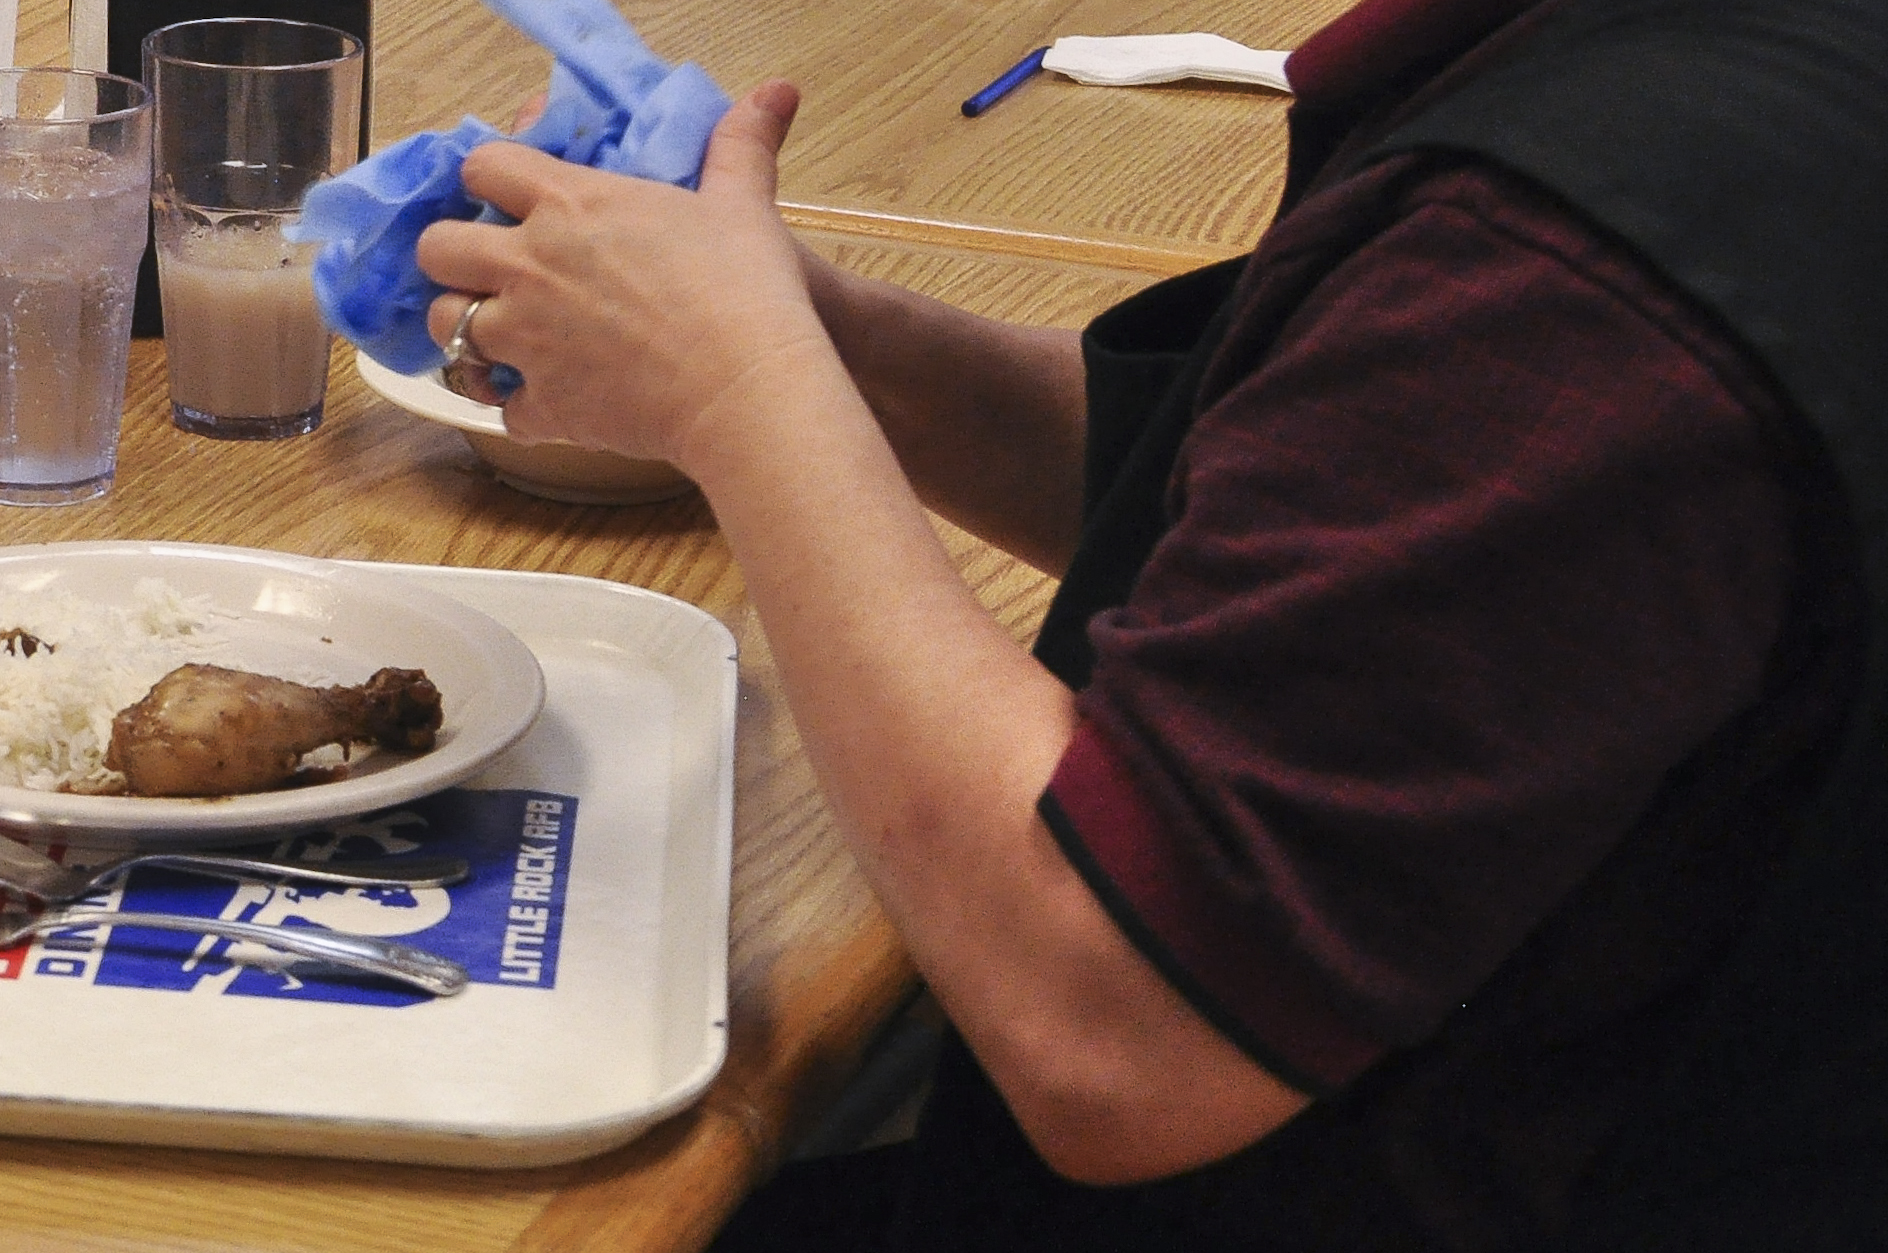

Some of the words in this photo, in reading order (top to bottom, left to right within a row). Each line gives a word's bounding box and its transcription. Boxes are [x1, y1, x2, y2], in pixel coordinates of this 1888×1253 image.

[522, 799, 563, 840] AFB
[511, 844, 558, 902] ROCK
[499, 905, 550, 983] LITTLE
